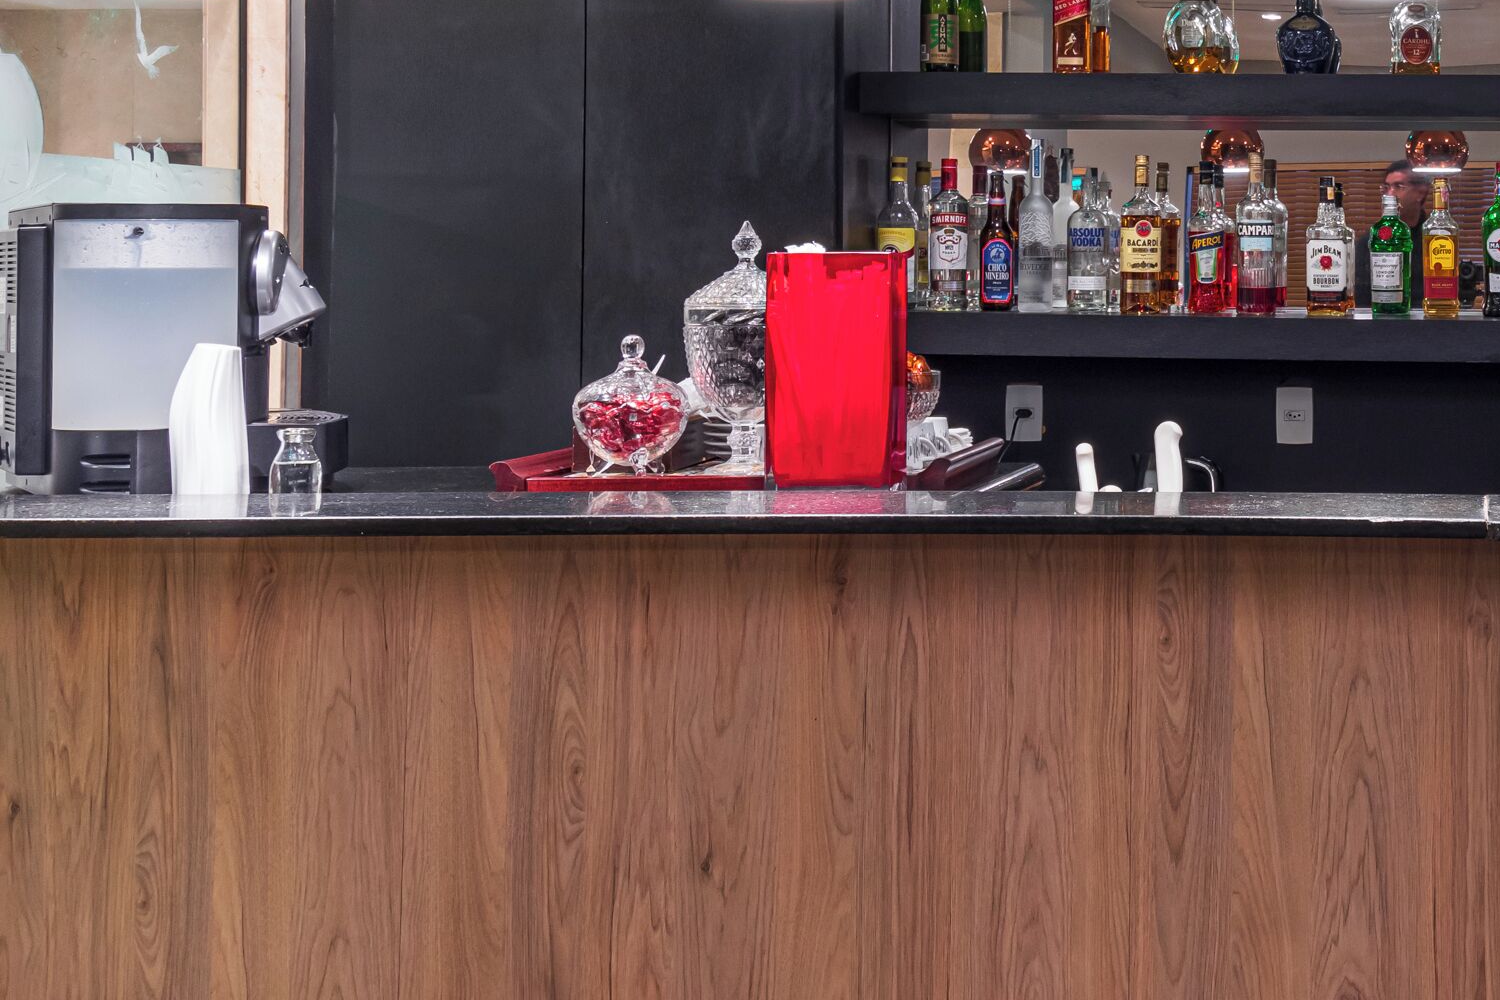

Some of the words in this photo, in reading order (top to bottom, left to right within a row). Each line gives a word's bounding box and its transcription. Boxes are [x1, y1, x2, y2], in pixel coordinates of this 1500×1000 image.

[931, 215, 966, 224] SMIRNOFF
[1069, 227, 1104, 237] ABSOLUT
[1071, 237, 1102, 247] VODKA
[1192, 236, 1221, 250] APEROL
[988, 263, 1007, 272] CHICO
